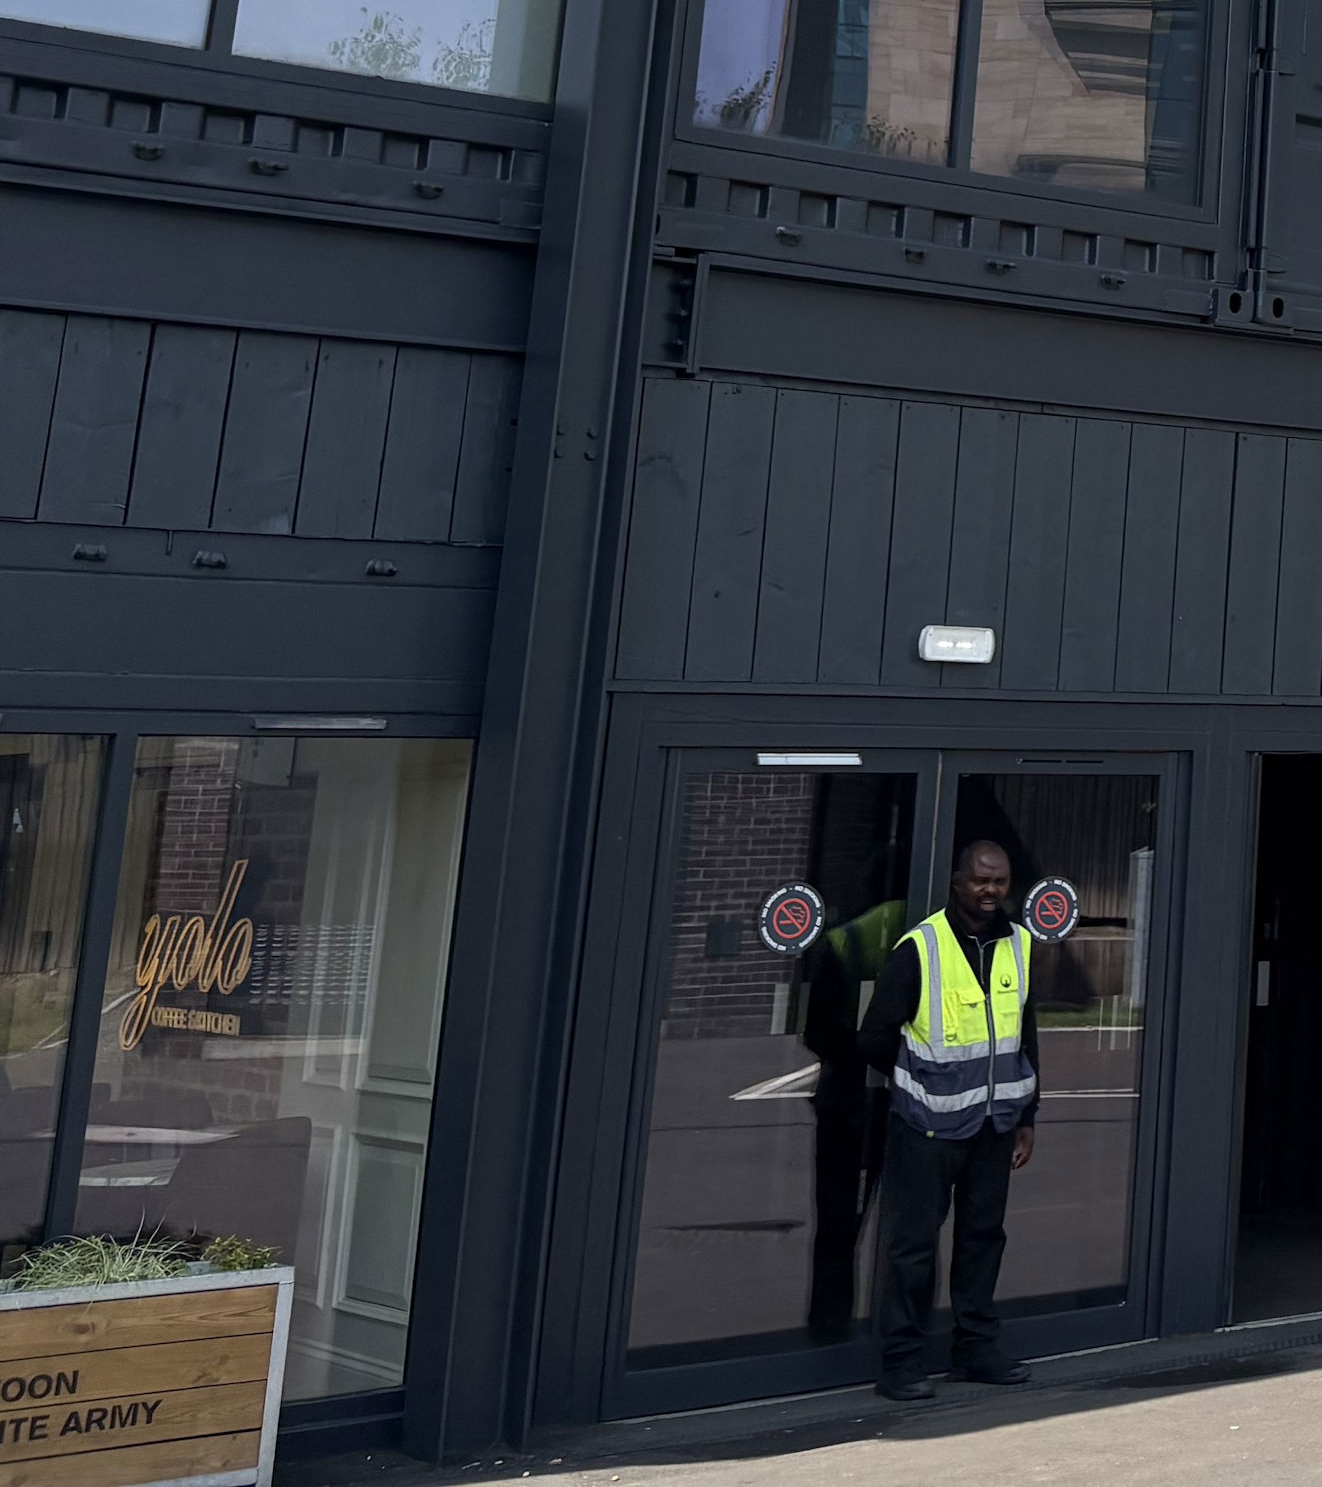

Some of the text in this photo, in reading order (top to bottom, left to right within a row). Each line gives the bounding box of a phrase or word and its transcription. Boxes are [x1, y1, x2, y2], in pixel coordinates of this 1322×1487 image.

[0, 1370, 79, 1403] OON
[0, 1399, 163, 1444] ITE ARMY
